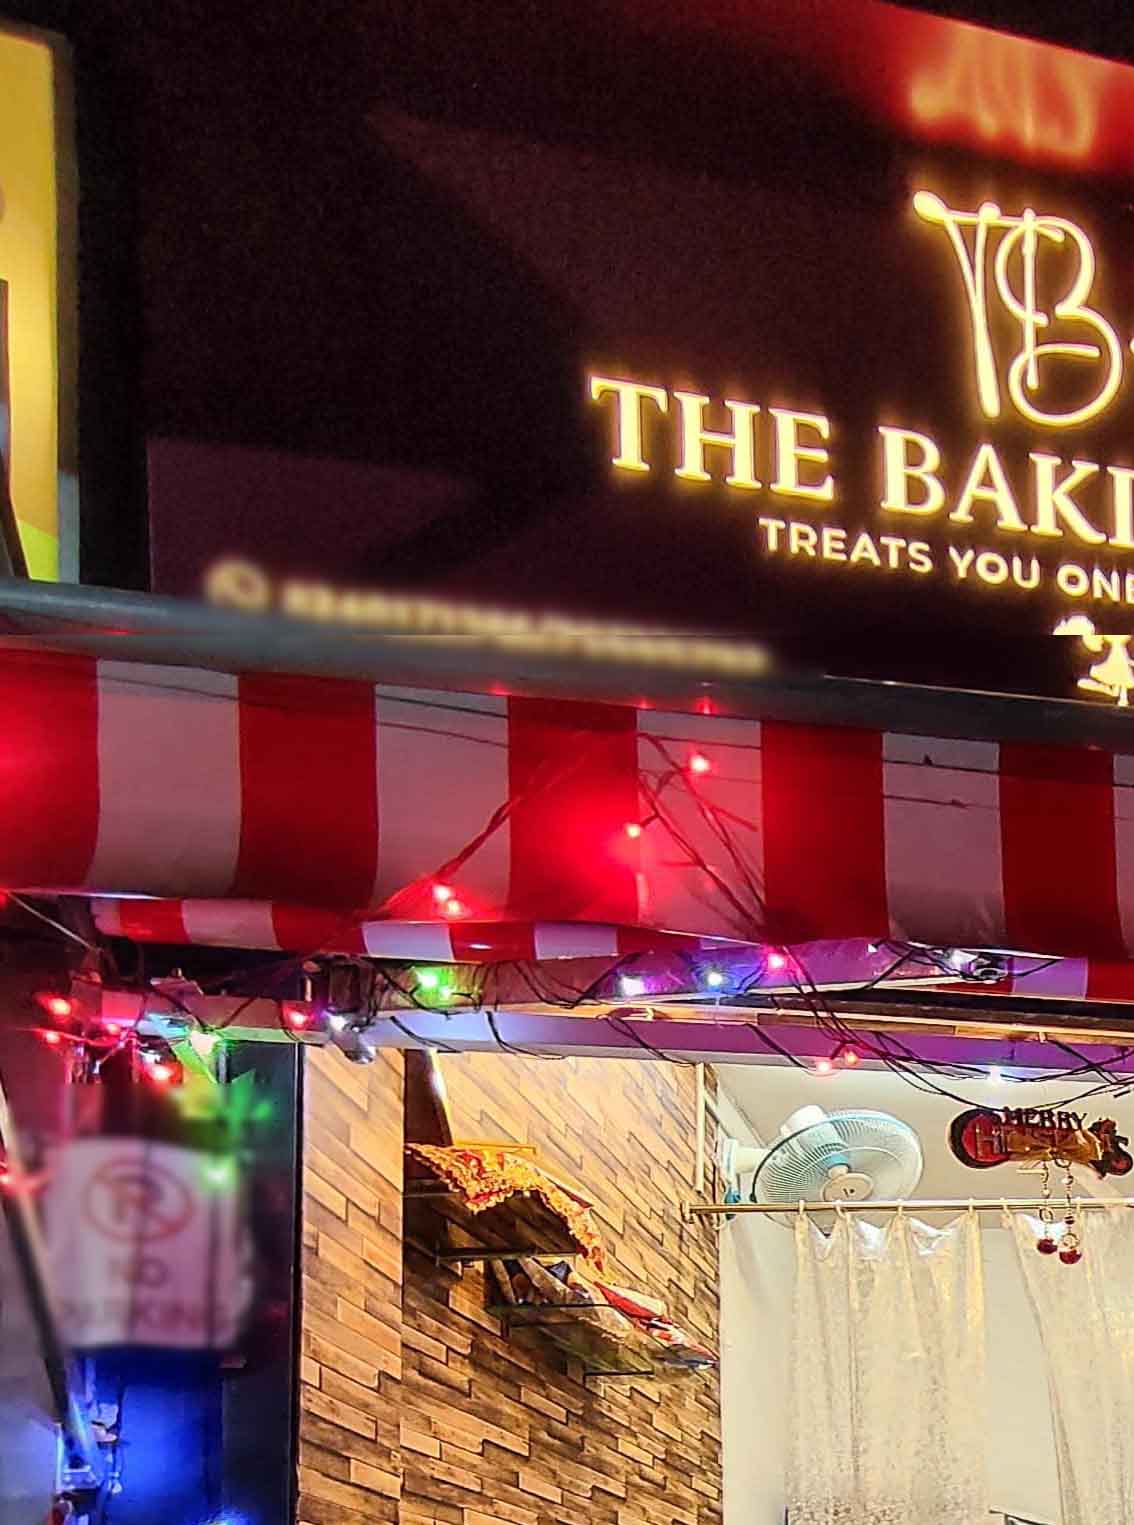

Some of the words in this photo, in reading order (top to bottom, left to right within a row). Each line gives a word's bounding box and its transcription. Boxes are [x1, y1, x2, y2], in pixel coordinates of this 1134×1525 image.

[589, 375, 835, 502] THE
[757, 517, 934, 574] TREATS
[948, 545, 1041, 590] YOU
